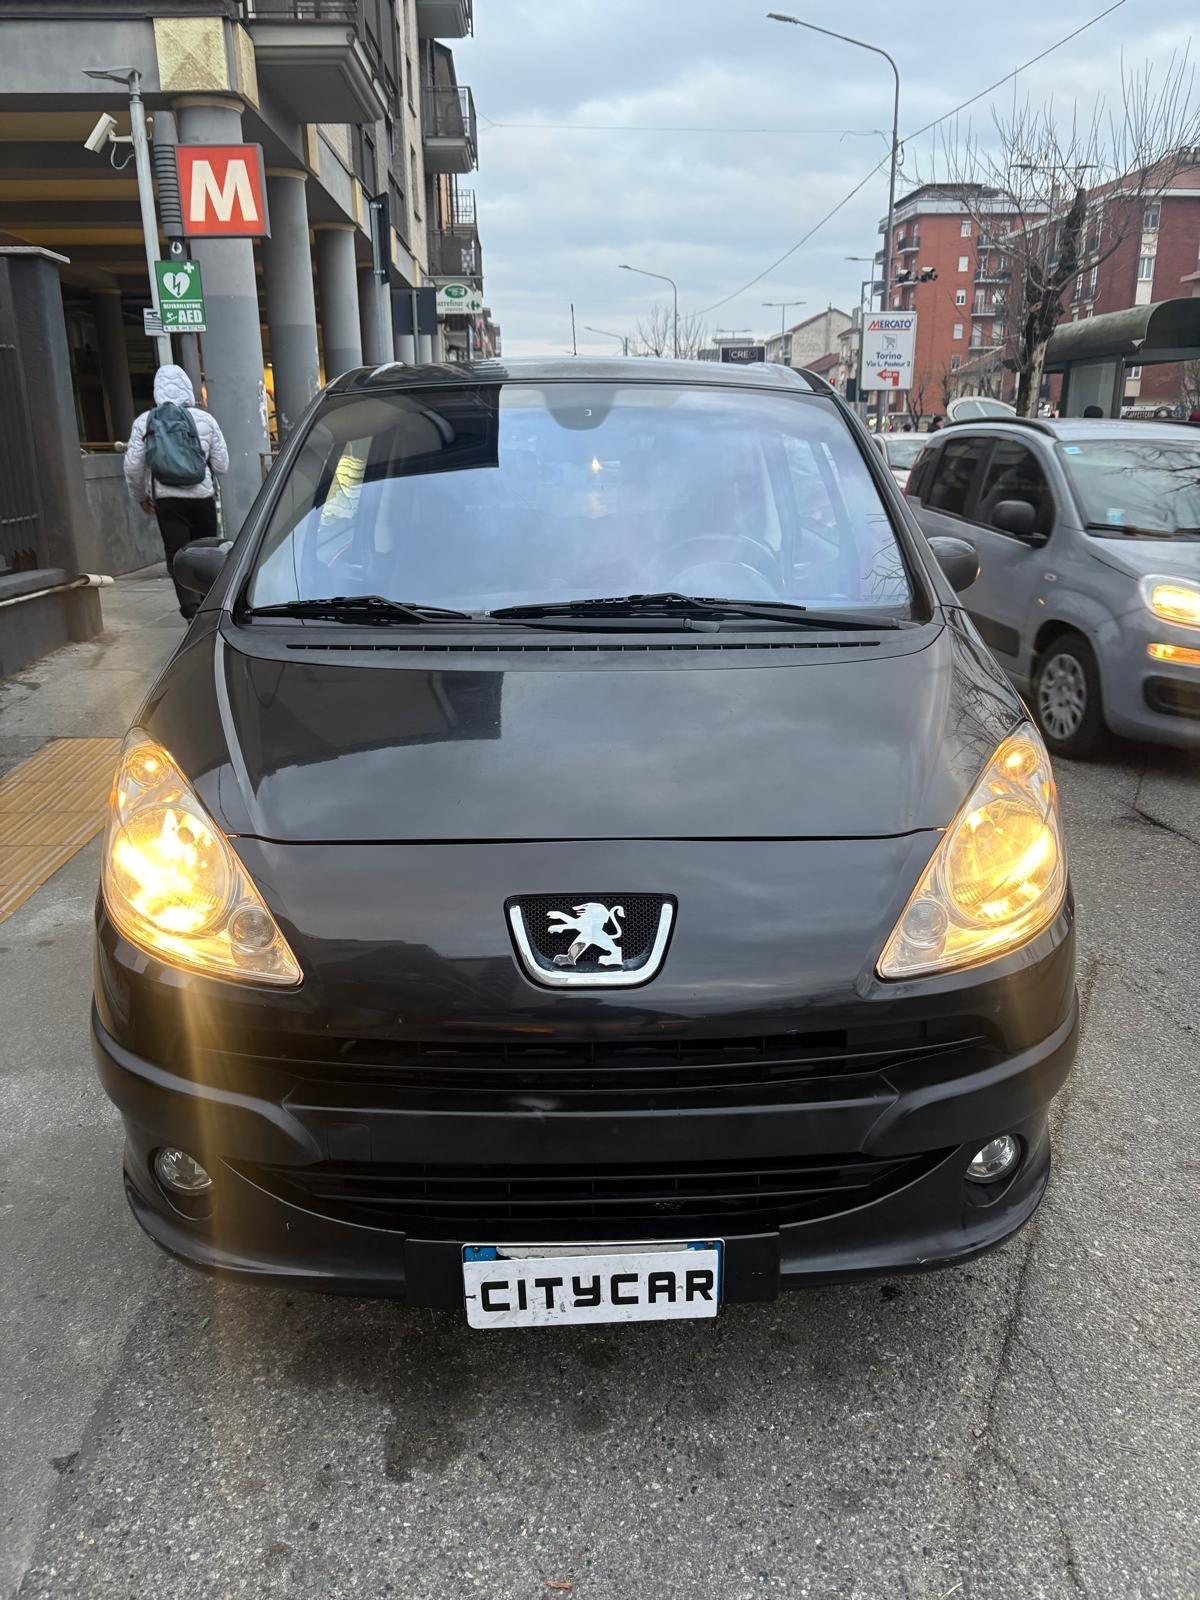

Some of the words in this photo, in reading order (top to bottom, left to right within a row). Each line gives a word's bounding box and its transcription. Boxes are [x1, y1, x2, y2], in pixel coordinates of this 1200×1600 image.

[190, 160, 259, 222] M
[178, 310, 203, 324] AED
[876, 351, 902, 360] Torino
[480, 1269, 714, 1312] CITYCAR
